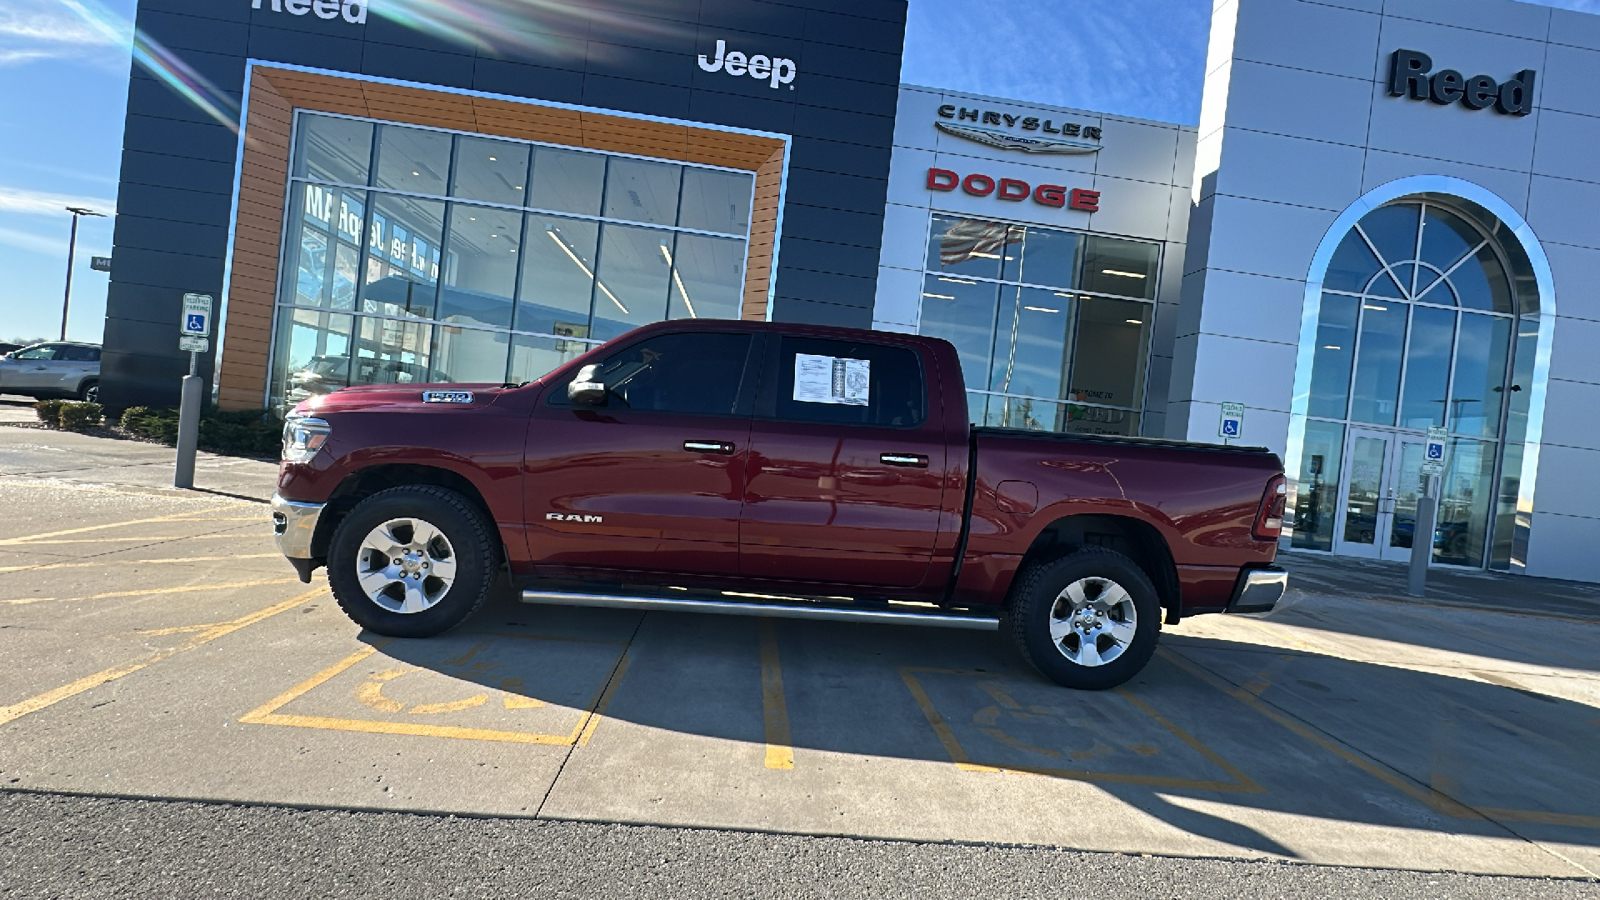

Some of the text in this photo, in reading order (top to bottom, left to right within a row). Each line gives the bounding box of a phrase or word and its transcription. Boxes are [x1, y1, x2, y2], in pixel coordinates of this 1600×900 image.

[698, 39, 796, 89] Jeep
[1388, 48, 1536, 117] Reed
[938, 104, 1102, 140] CHRYSLER
[927, 167, 1101, 212] DODGE
[546, 512, 603, 523] RAM
